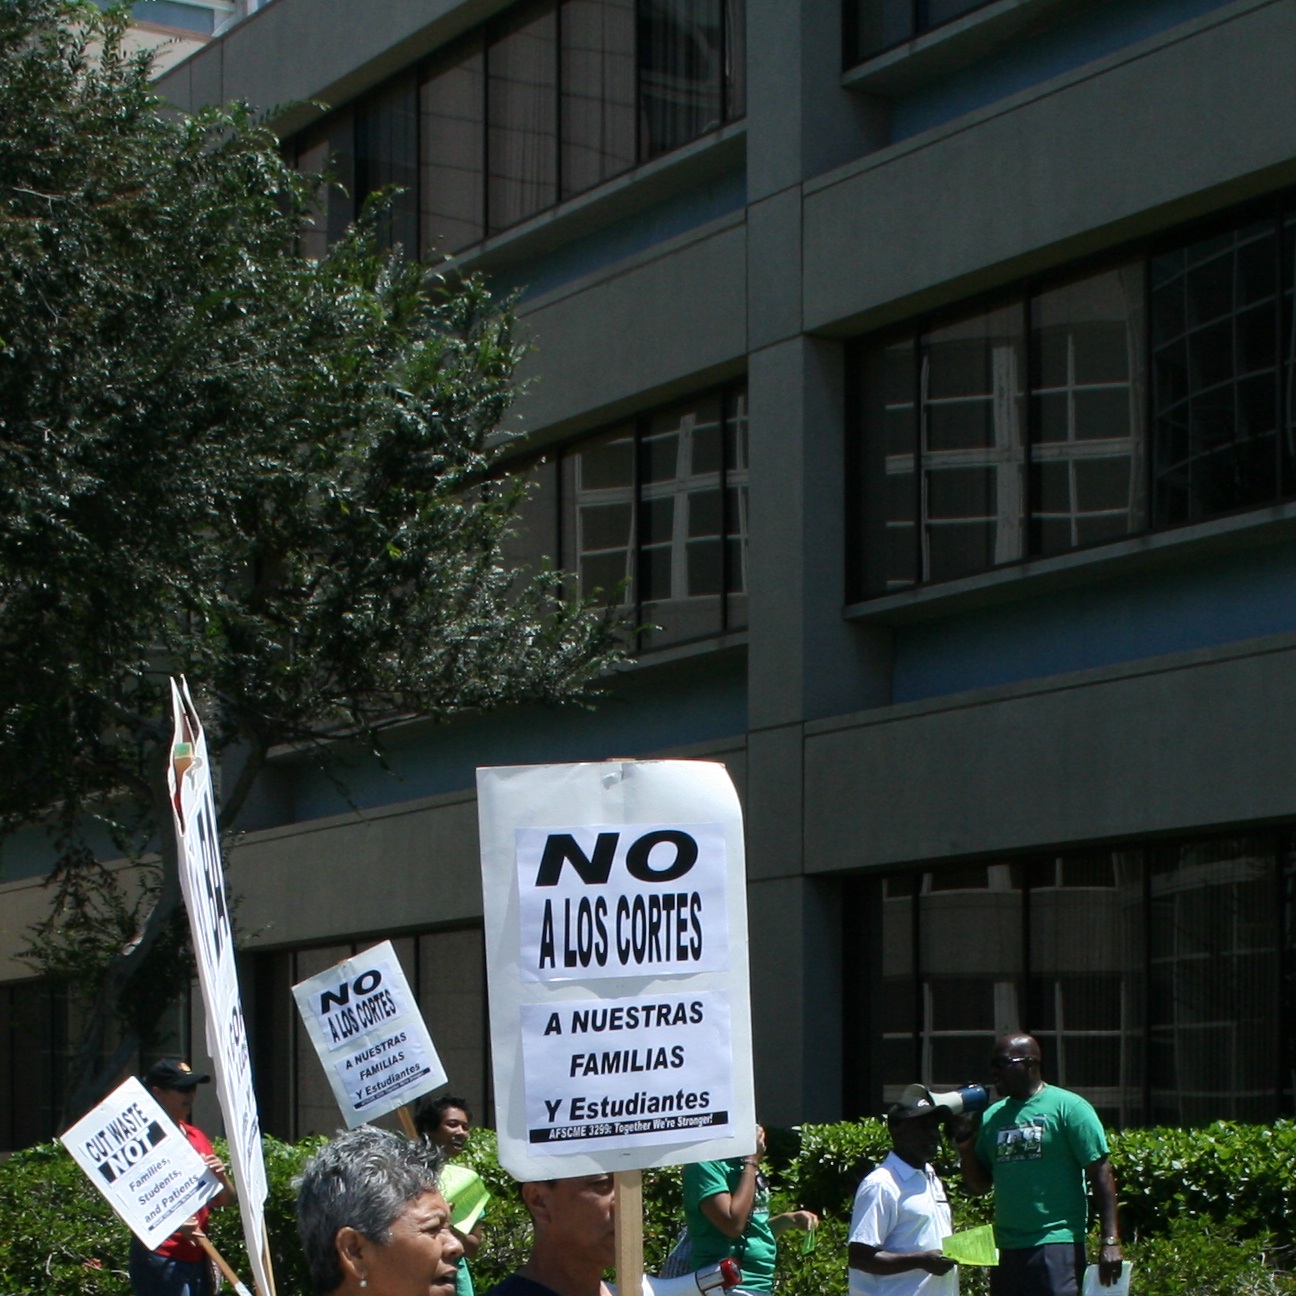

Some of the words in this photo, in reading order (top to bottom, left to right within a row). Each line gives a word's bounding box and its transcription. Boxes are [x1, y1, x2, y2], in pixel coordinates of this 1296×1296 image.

[535, 830, 699, 887] NO
[539, 899, 555, 969] A
[563, 895, 608, 968] LOS
[616, 891, 703, 964] CORTES
[320, 970, 382, 1015] NO
[328, 1017, 341, 1043] A
[335, 1007, 359, 1038] LOS
[355, 989, 397, 1028] CORTES
[544, 1011, 562, 1036] A
[571, 1001, 704, 1033] NUESTRAS
[345, 1059, 353, 1070] A
[354, 1032, 407, 1065] NUESTRAS
[359, 1051, 405, 1081] FAMILIAS
[569, 1045, 685, 1078] FAMILIAS
[355, 1089, 364, 1100] Y
[365, 1063, 421, 1095] Estudiantes
[544, 1098, 563, 1123] Y
[570, 1087, 710, 1121] Estudiantes
[85, 1129, 114, 1163] CUT
[106, 1102, 149, 1146] WASTE
[548, 1126, 587, 1140] AFSCME
[588, 1123, 612, 1137] 3299:
[614, 1120, 651, 1136] Together
[653, 1117, 675, 1130] We're
[676, 1113, 714, 1128] Stronger!
[106, 1127, 154, 1178] NOT
[128, 1157, 172, 1192] Families,
[138, 1169, 183, 1206] Students,
[144, 1204, 162, 1223] and
[161, 1174, 200, 1207] Patients
